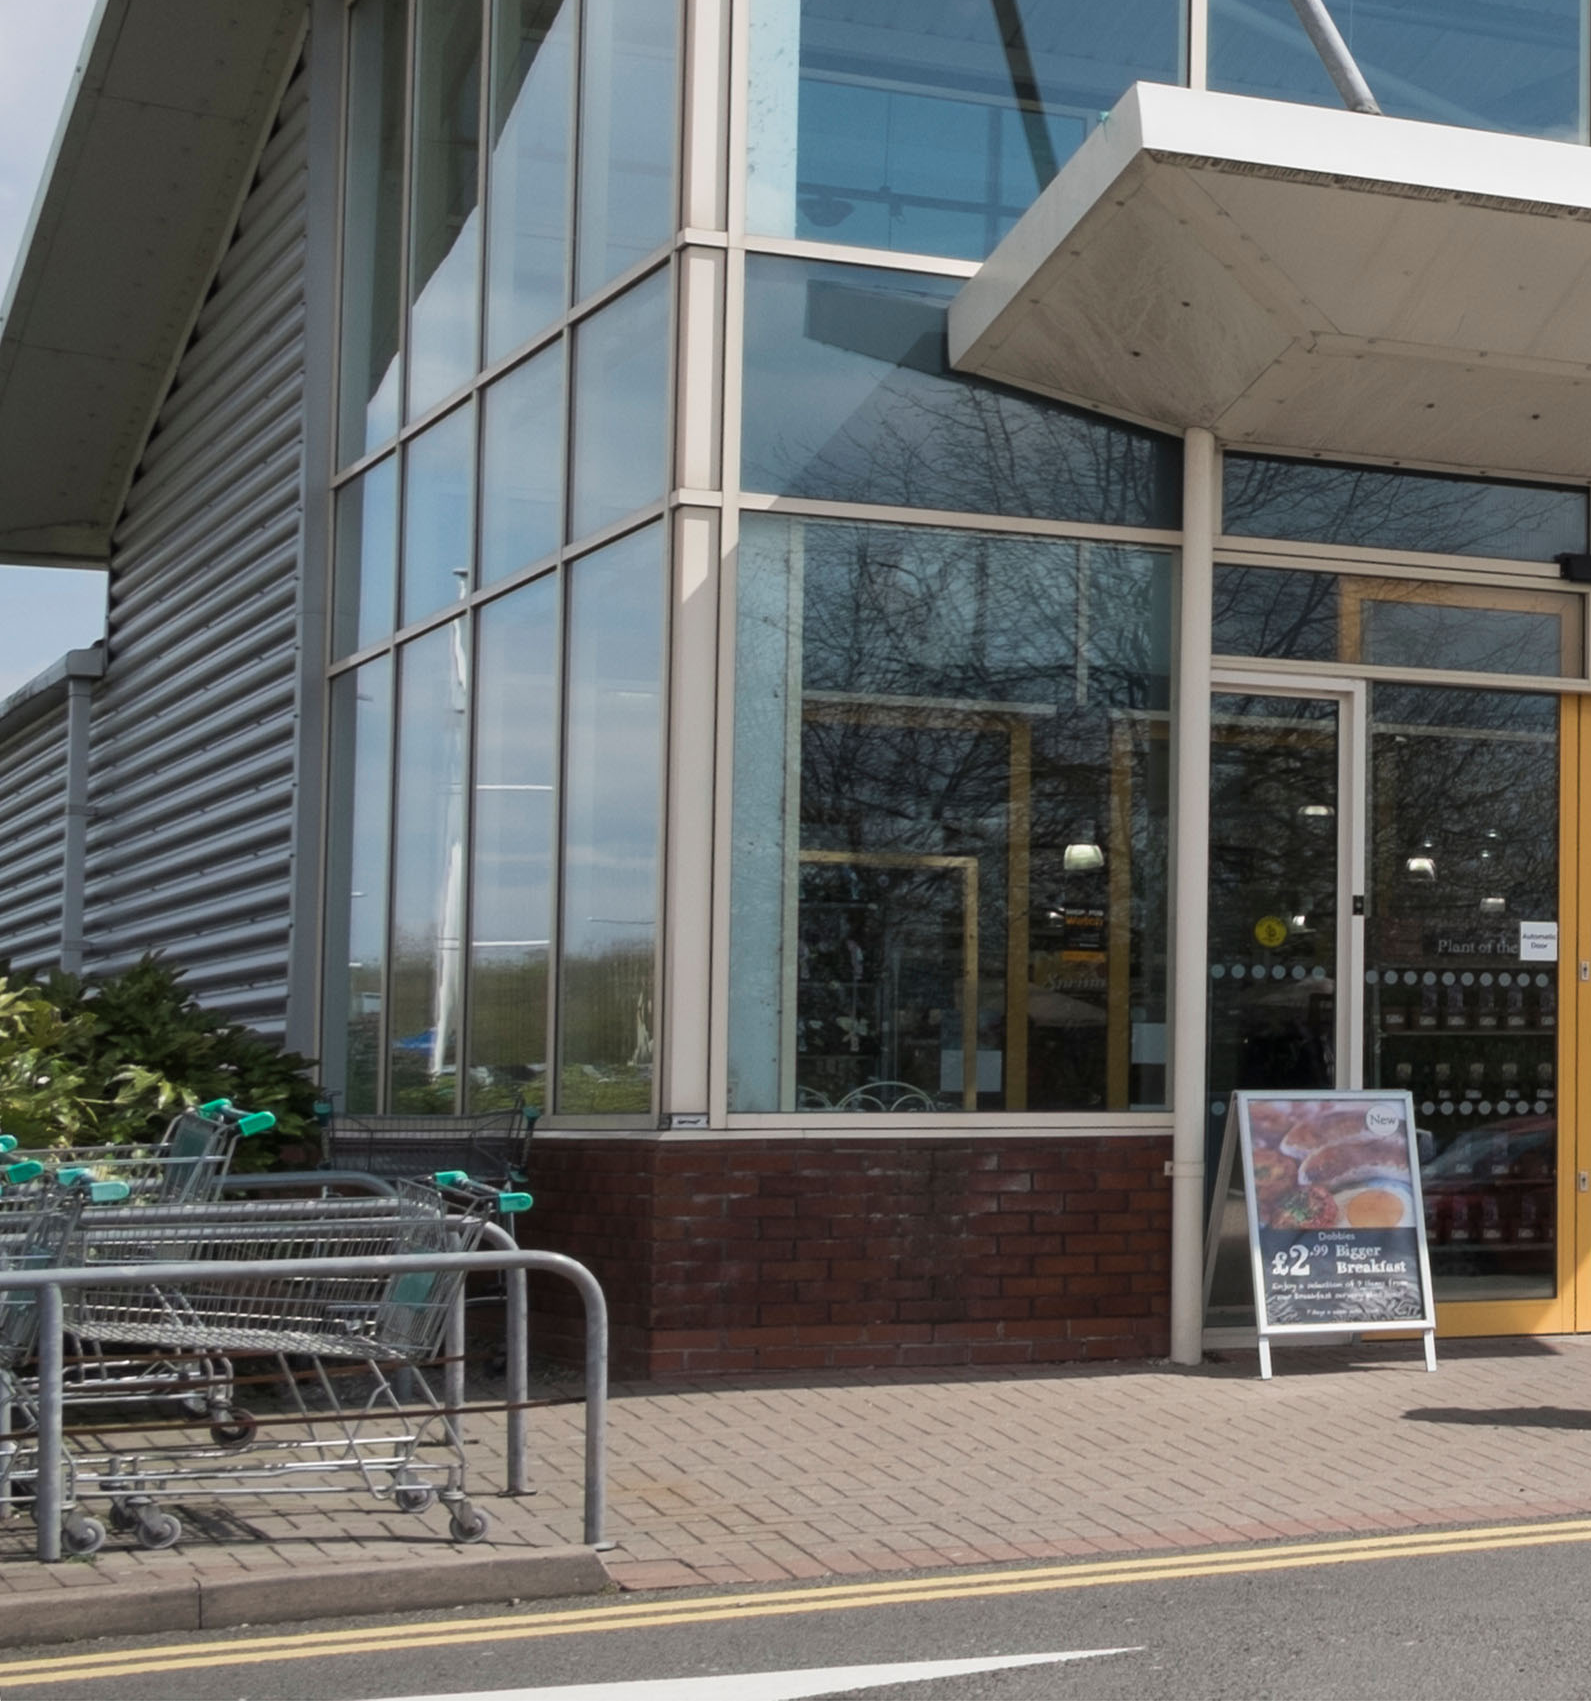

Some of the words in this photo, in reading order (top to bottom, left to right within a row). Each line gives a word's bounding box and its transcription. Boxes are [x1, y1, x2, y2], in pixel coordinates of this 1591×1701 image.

[1522, 933, 1556, 941] Automatic
[1438, 939, 1475, 953] Plant
[1478, 940, 1495, 953] of
[1497, 940, 1518, 953] the
[1369, 1114, 1396, 1126] New
[1318, 1231, 1356, 1241] Dobbies
[1271, 1244, 1329, 1277] £2.99
[1335, 1244, 1382, 1260] Bigger
[1336, 1258, 1407, 1274] Breakfast
[1271, 1282, 1296, 1292] Enjoy
